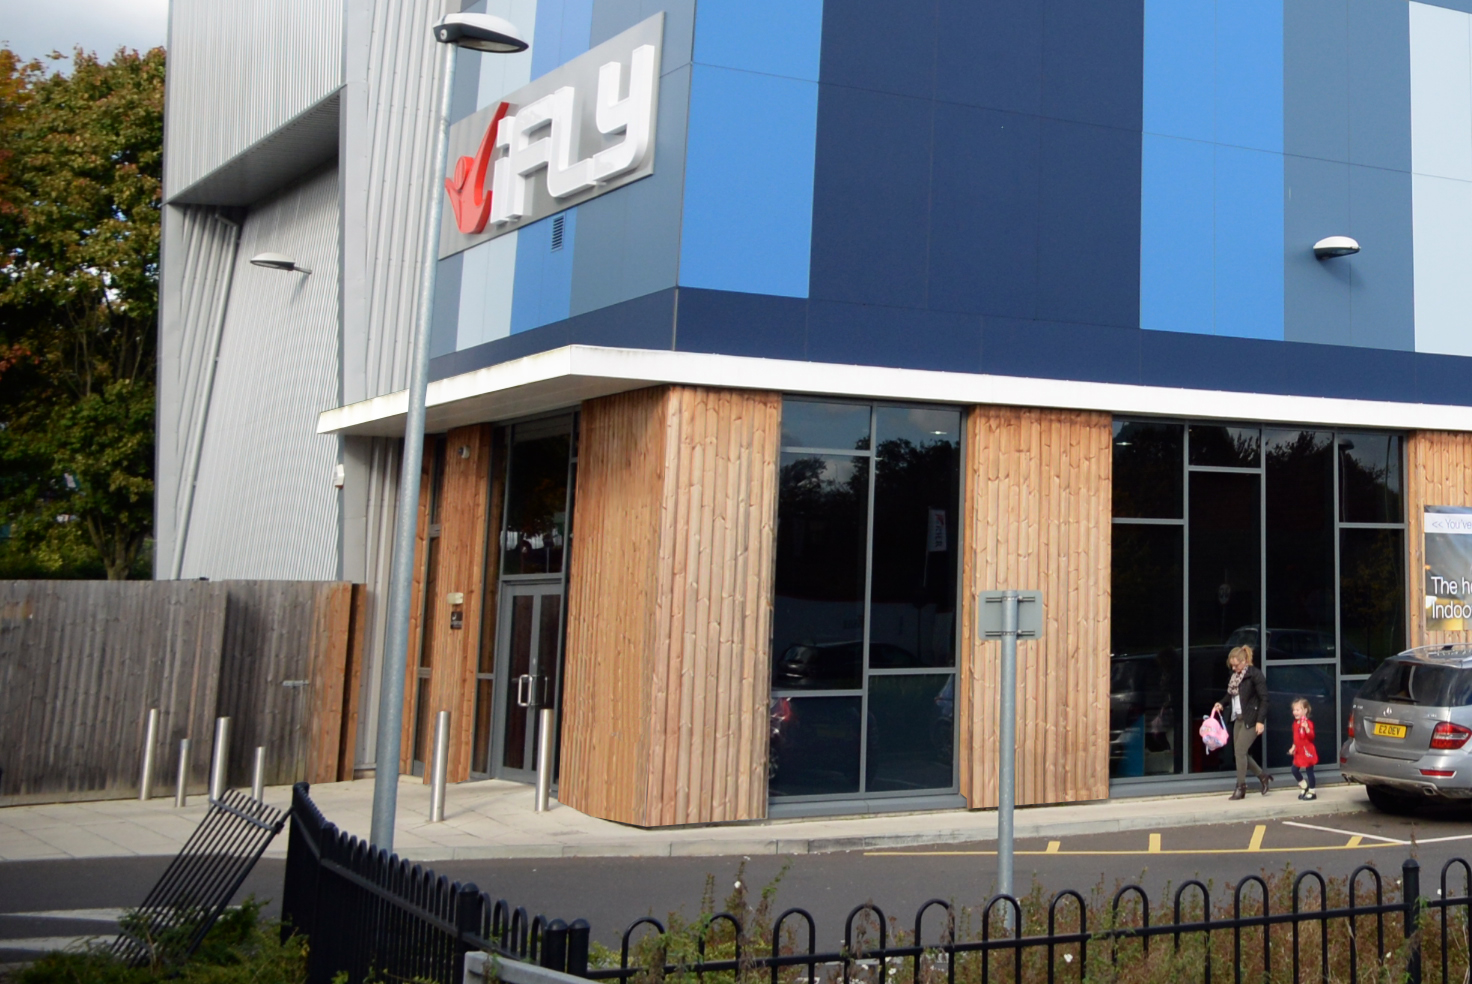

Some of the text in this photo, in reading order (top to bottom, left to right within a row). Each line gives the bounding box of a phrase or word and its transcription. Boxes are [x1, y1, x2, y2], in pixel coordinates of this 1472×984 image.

[490, 44, 655, 224] iFLY
[1445, 517, 1472, 529] You've
[1430, 576, 1457, 594] The
